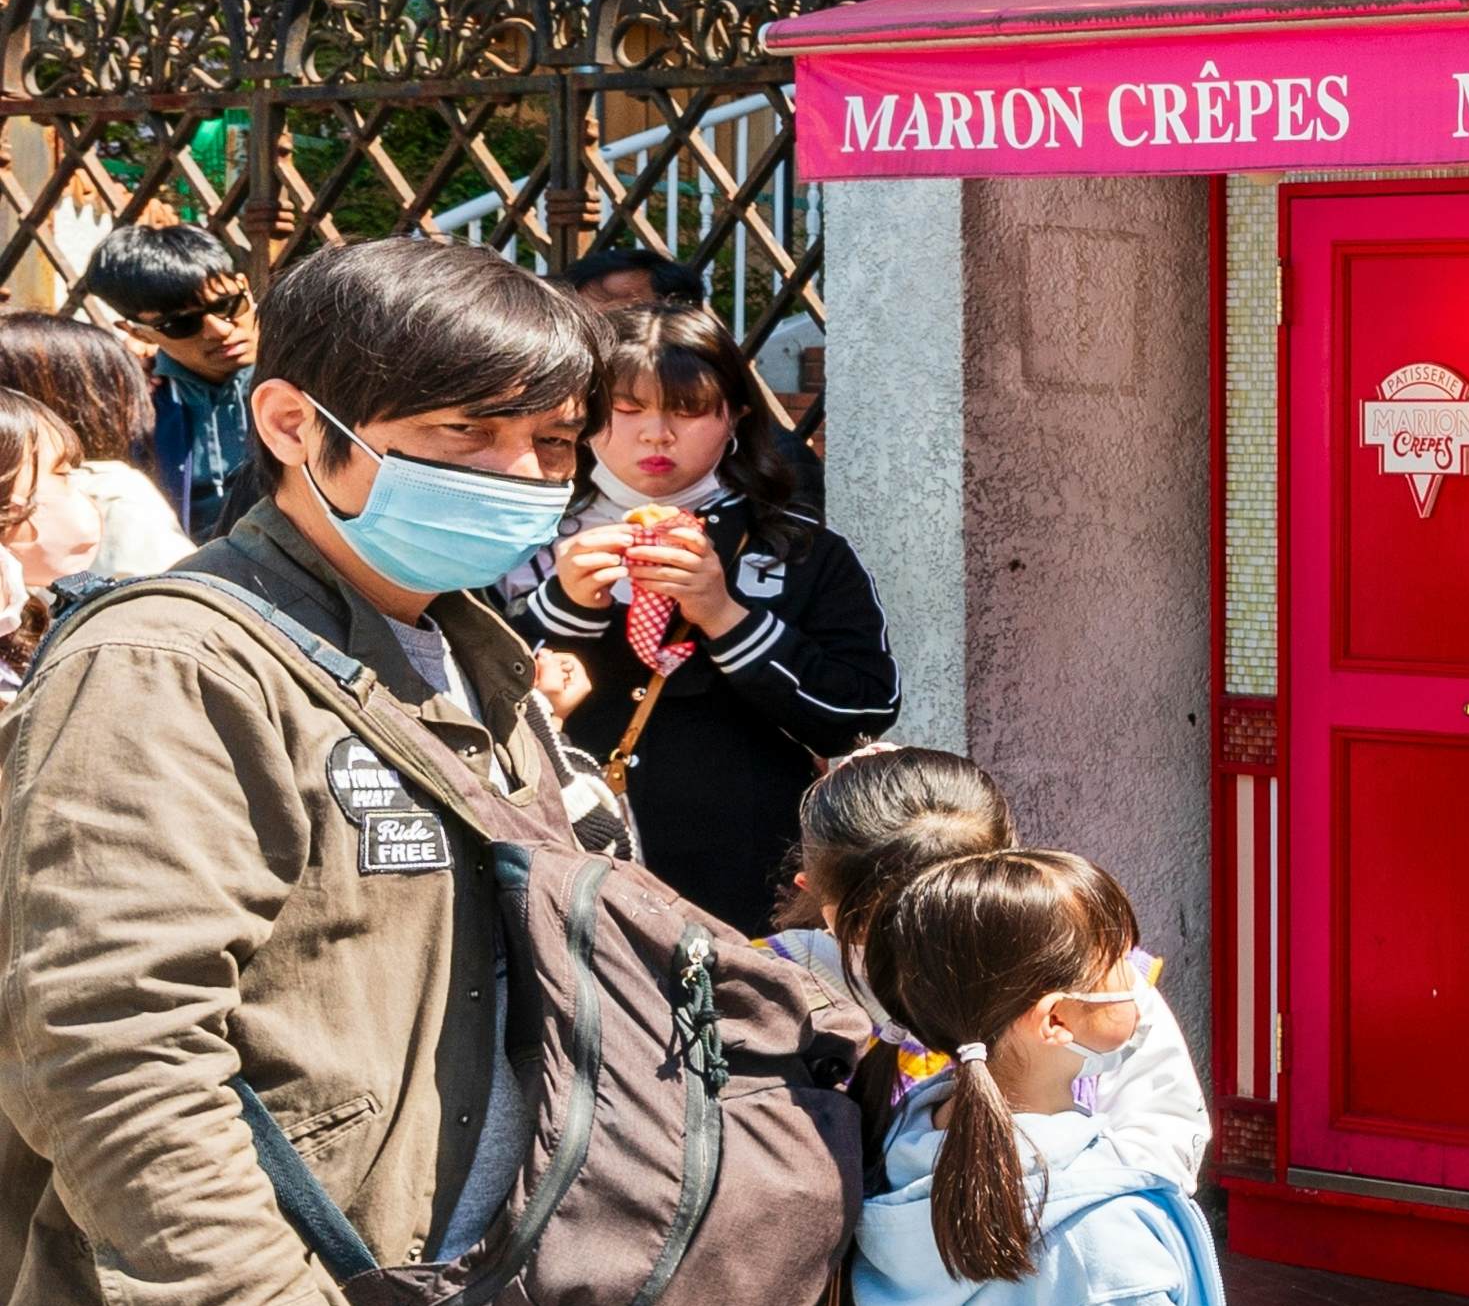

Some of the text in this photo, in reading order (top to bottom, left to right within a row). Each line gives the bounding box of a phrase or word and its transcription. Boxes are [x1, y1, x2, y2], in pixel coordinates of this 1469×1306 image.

[841, 61, 1350, 154] MARION CRÊPES
[1387, 366, 1459, 393] PATISSERIE
[377, 819, 434, 843] Ride
[378, 842, 437, 864] FREE
